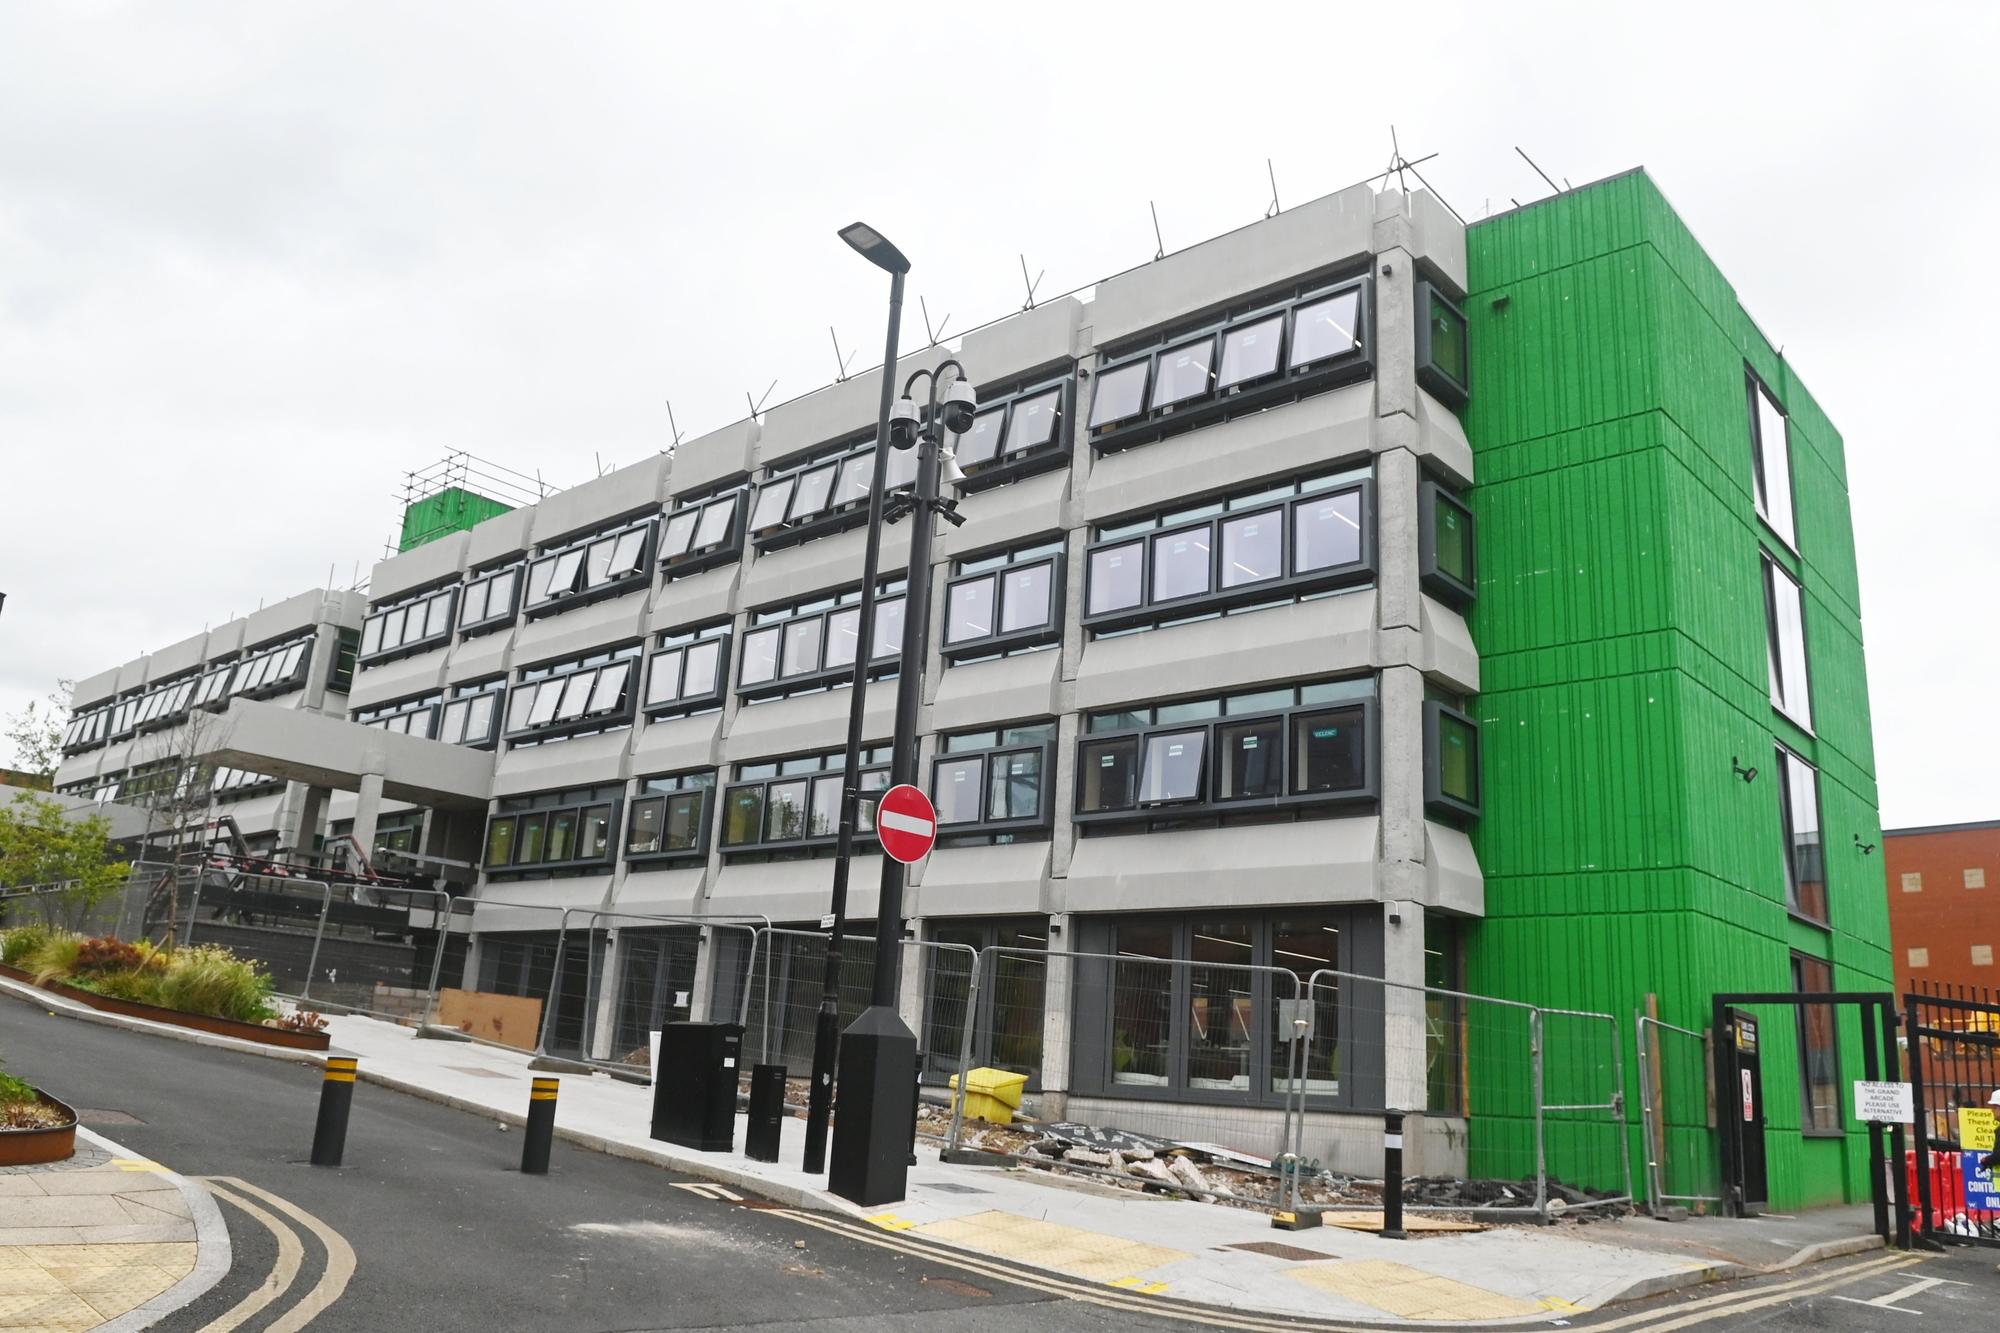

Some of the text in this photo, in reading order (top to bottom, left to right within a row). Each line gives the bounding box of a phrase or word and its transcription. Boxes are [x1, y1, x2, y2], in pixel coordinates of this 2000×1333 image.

[1871, 1081, 1895, 1089] ACCESS
[1863, 1107, 1902, 1116] ALTERNATIVE
[1967, 1110, 1992, 1118] Please
[1967, 1118, 1990, 1126] These
[1975, 1126, 1993, 1134] Clea
[1976, 1142, 1993, 1150] Than
[1967, 1180, 1996, 1194] CONTR
[1985, 1196, 2000, 1208] ONL
